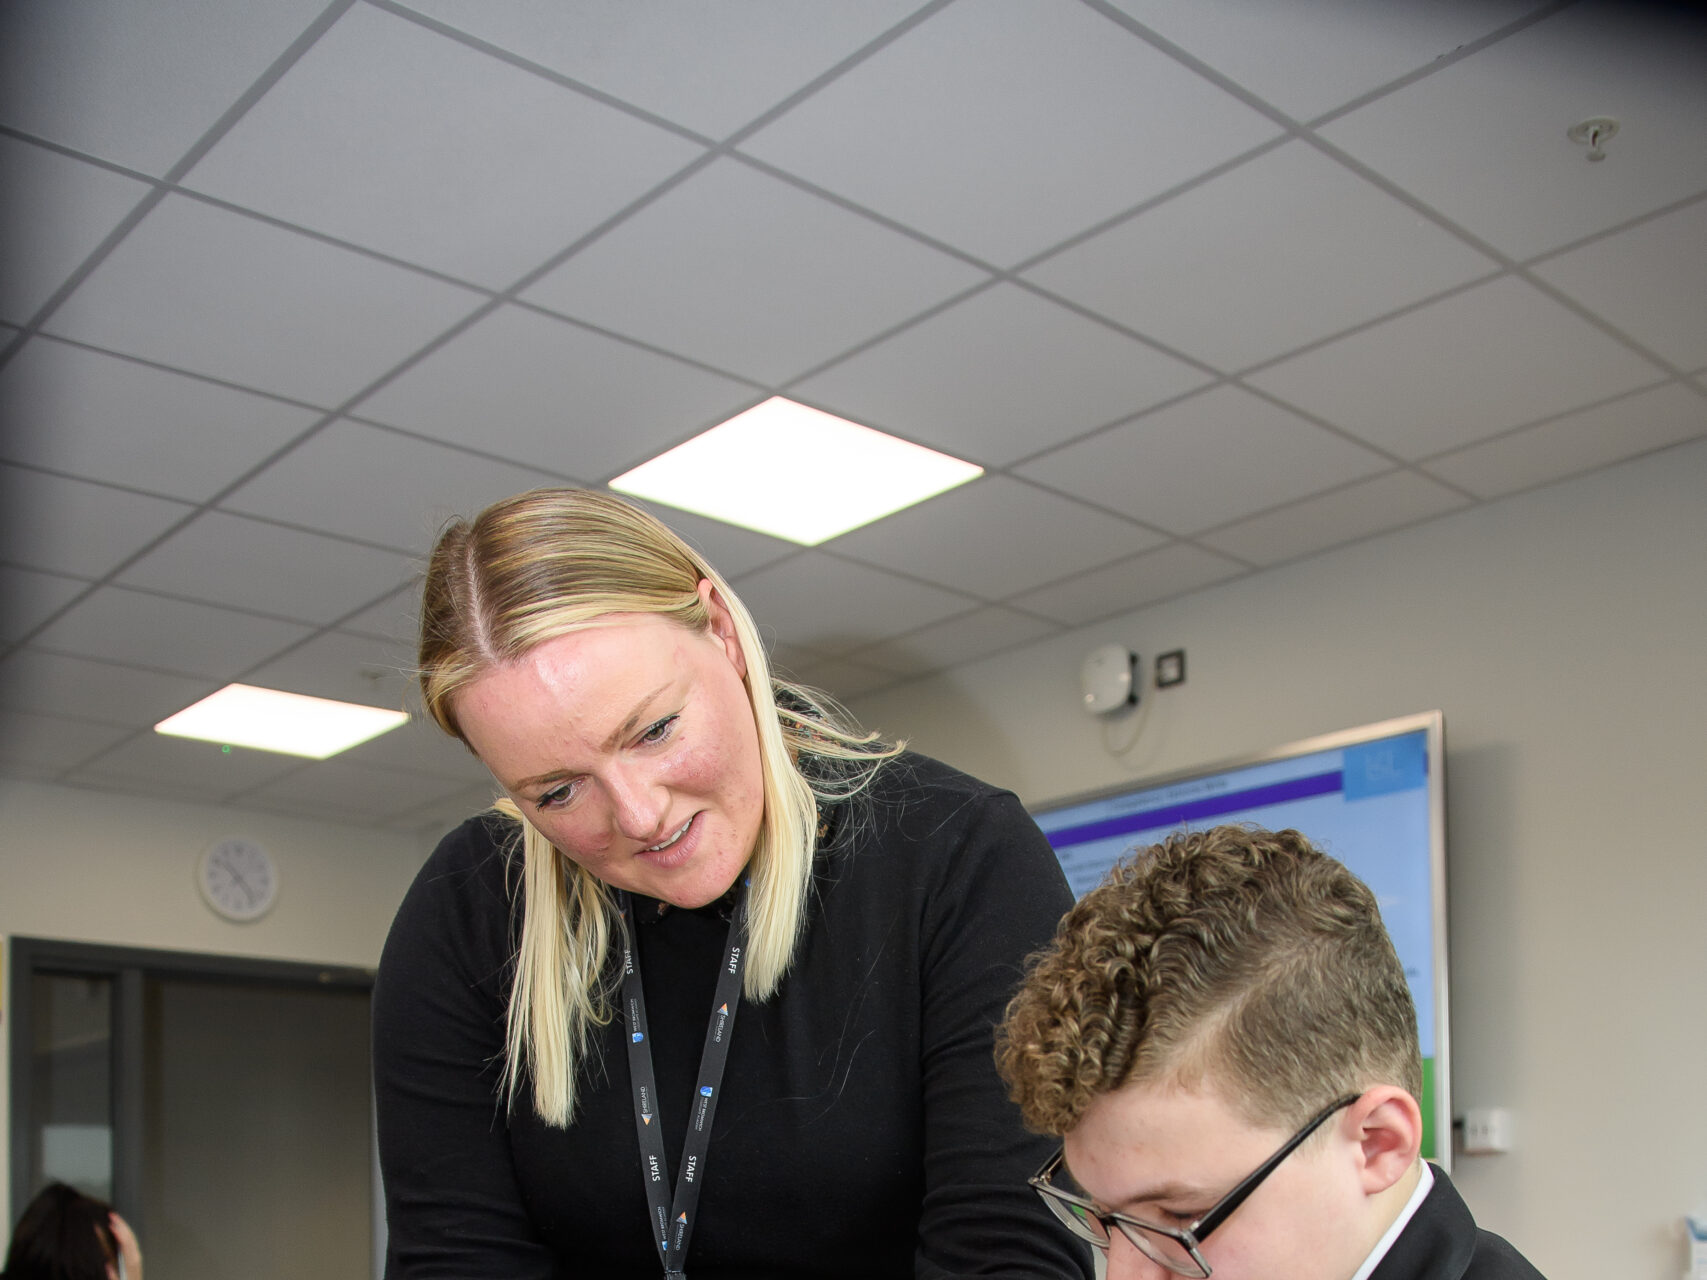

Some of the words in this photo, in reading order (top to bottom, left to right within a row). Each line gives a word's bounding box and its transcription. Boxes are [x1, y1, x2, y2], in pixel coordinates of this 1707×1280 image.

[728, 947, 740, 975] STAFF
[716, 1015, 726, 1043] SHIRELAND
[640, 1086, 648, 1114] SHIRELAND
[649, 1154, 661, 1182] STAFF
[685, 1155, 697, 1183] STAFF
